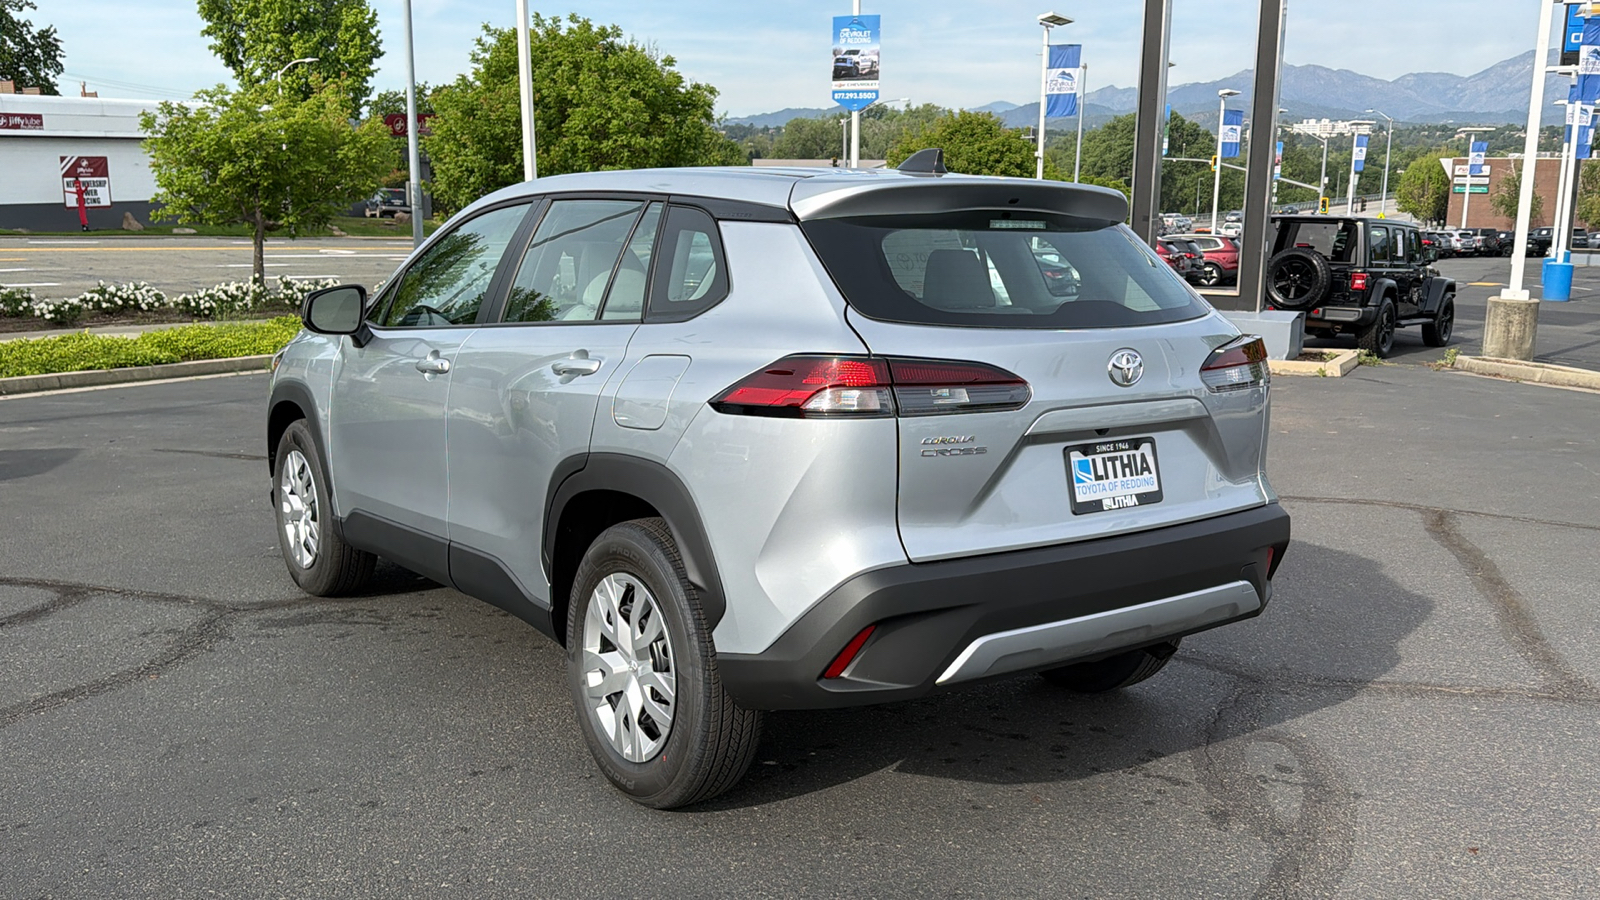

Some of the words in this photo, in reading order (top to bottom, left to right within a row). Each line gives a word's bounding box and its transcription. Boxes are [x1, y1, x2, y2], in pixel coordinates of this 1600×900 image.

[840, 30, 871, 38] CHEVROLET
[921, 434, 976, 445] COROLLA
[920, 446, 988, 457] CROSS
[1096, 443, 1114, 453] SINCE
[1115, 442, 1129, 451] 1946
[1091, 452, 1152, 482] LITHIA
[1076, 483, 1107, 496] TOYOTA
[1108, 481, 1119, 492] OF
[1120, 476, 1155, 491] REDDING
[1111, 494, 1139, 509] LITHIA
